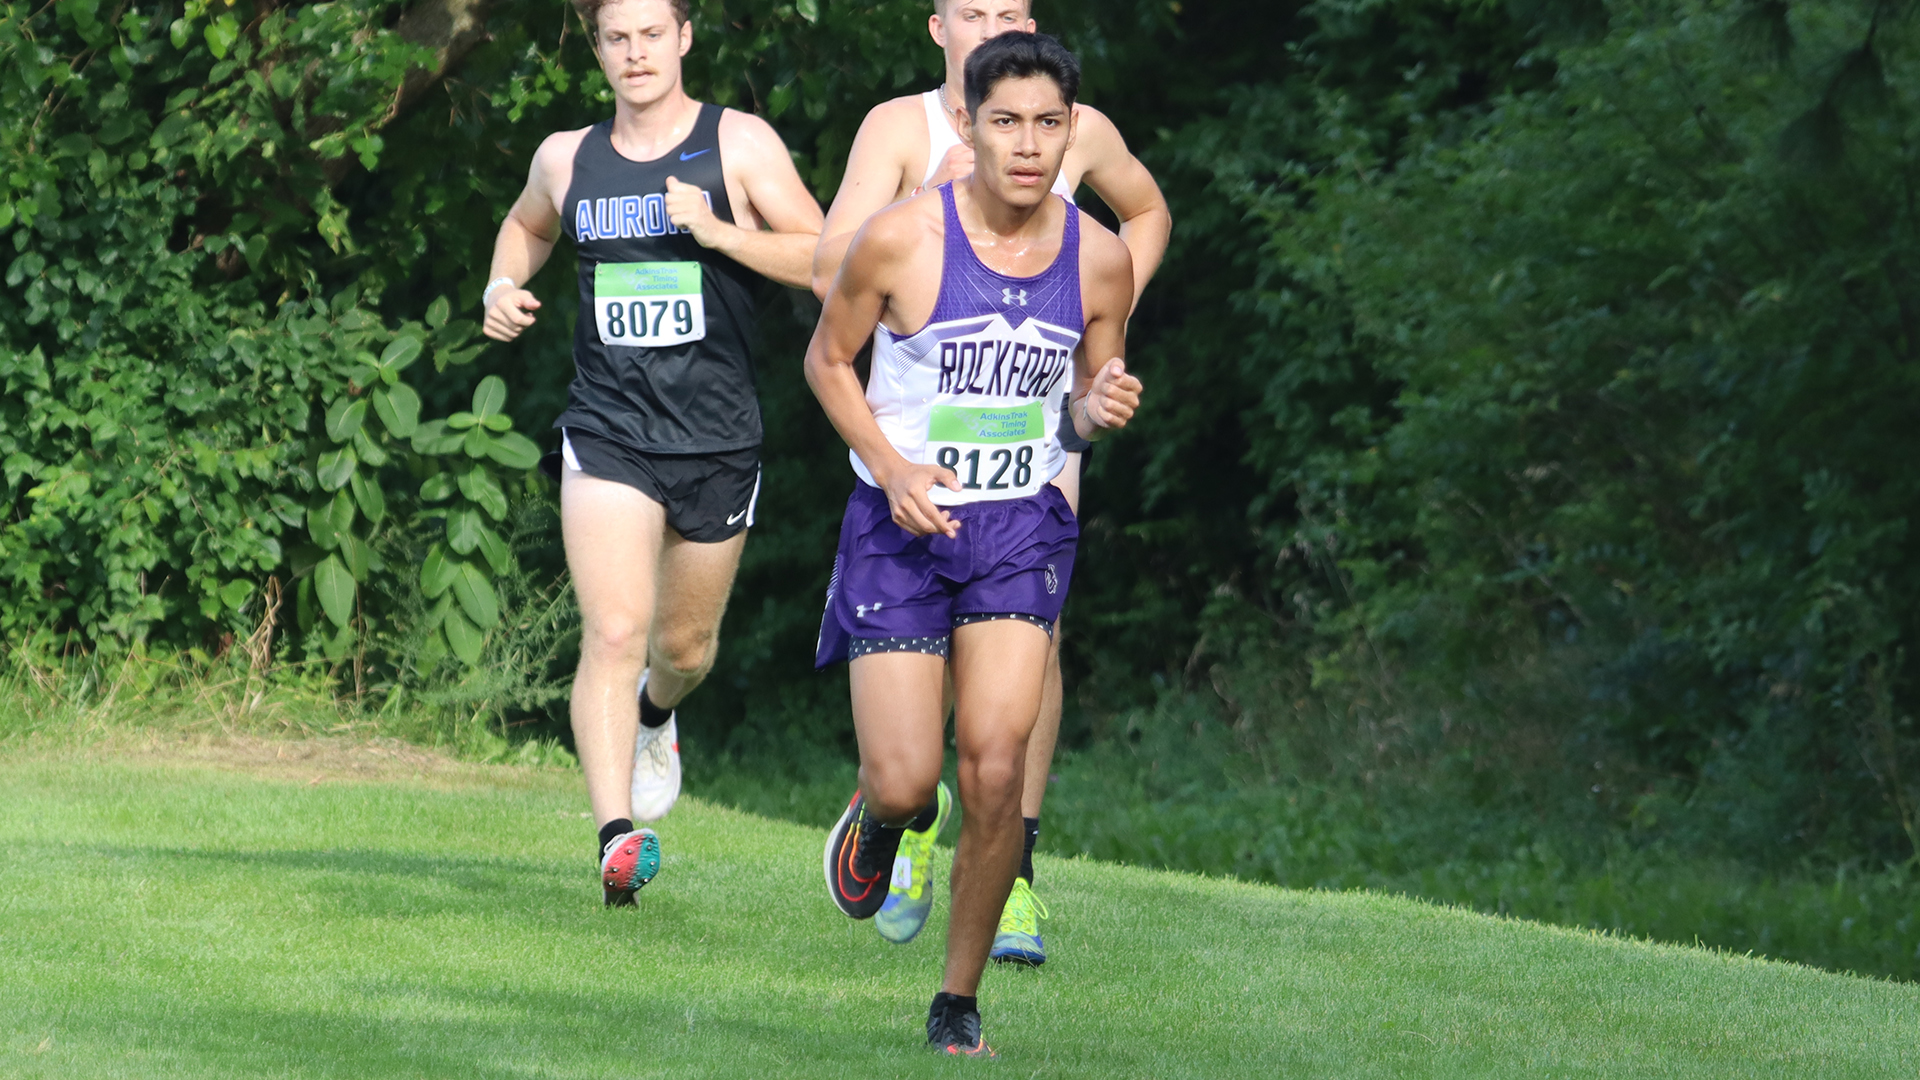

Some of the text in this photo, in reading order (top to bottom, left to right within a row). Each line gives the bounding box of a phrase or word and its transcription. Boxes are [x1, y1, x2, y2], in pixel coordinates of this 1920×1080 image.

[576, 190, 713, 242] AURO
[636, 283, 678, 291] Associates
[652, 275, 678, 283] Timing
[606, 299, 692, 338] 8079
[937, 340, 1068, 398] ROCKFORD
[979, 429, 1026, 437] Associates
[1001, 420, 1027, 428] Timing
[935, 445, 1033, 490] 8128
